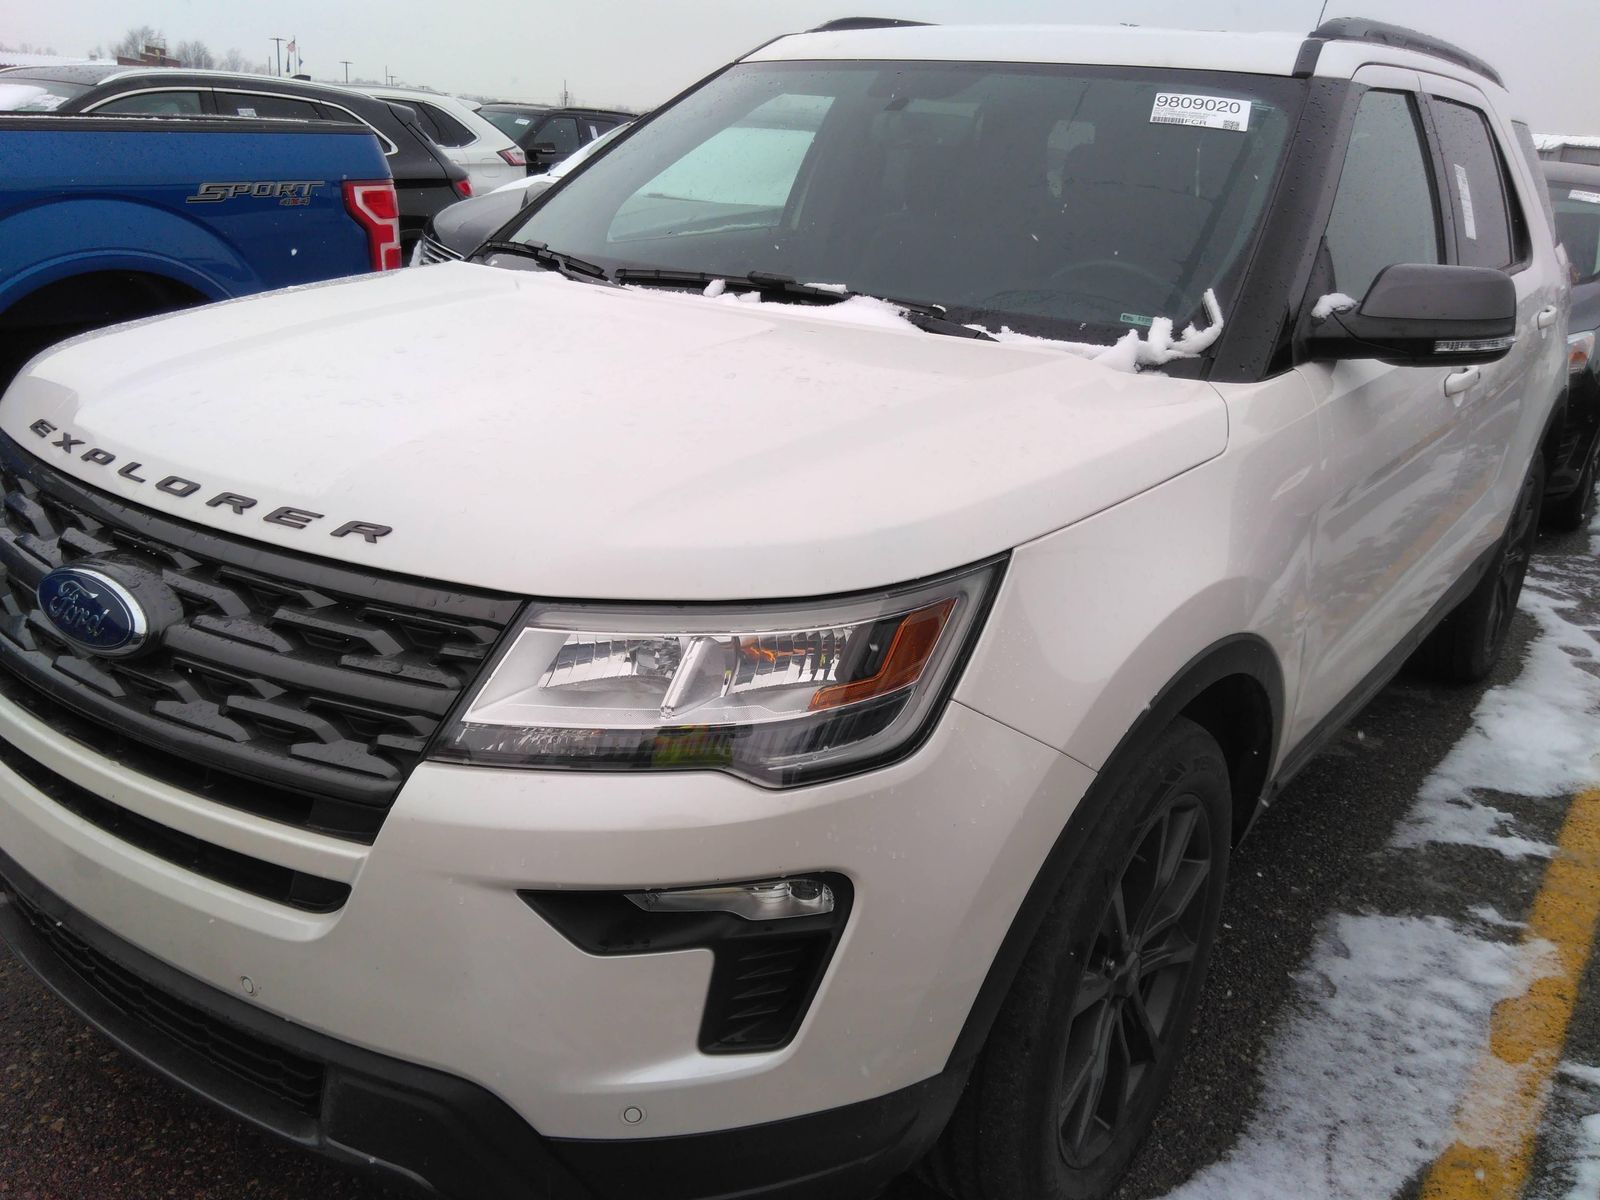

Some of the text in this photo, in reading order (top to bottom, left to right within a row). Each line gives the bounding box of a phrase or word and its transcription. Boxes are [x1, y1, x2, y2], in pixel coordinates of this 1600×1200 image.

[1156, 95, 1241, 114] 9809020
[186, 180, 325, 203] SPORT
[29, 418, 393, 544] EXPLORER
[49, 579, 110, 637] Ford
